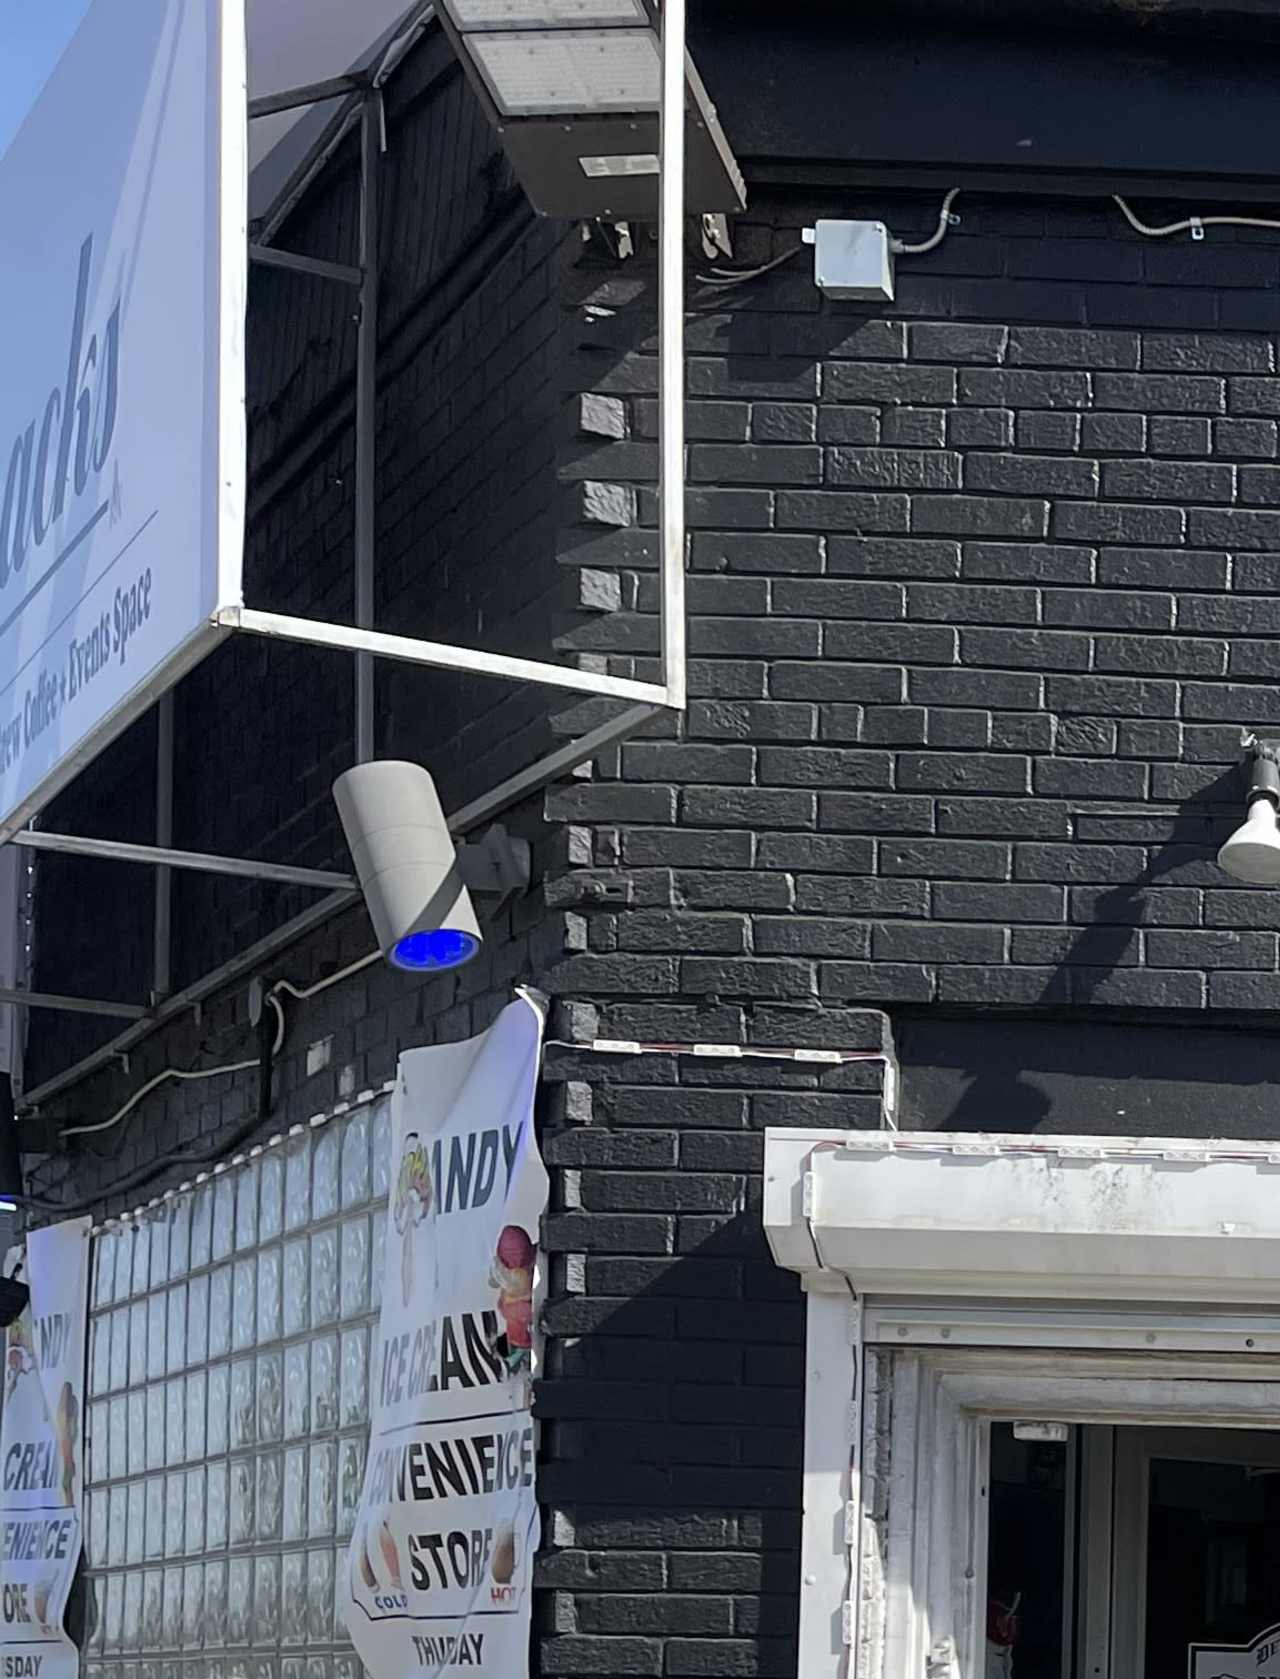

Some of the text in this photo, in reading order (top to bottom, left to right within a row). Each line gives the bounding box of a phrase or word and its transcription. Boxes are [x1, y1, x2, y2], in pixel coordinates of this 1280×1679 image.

[24, 669, 58, 751] Coffee
[68, 612, 110, 703] Events
[114, 567, 151, 666] Space
[374, 1593, 408, 1609] COLD
